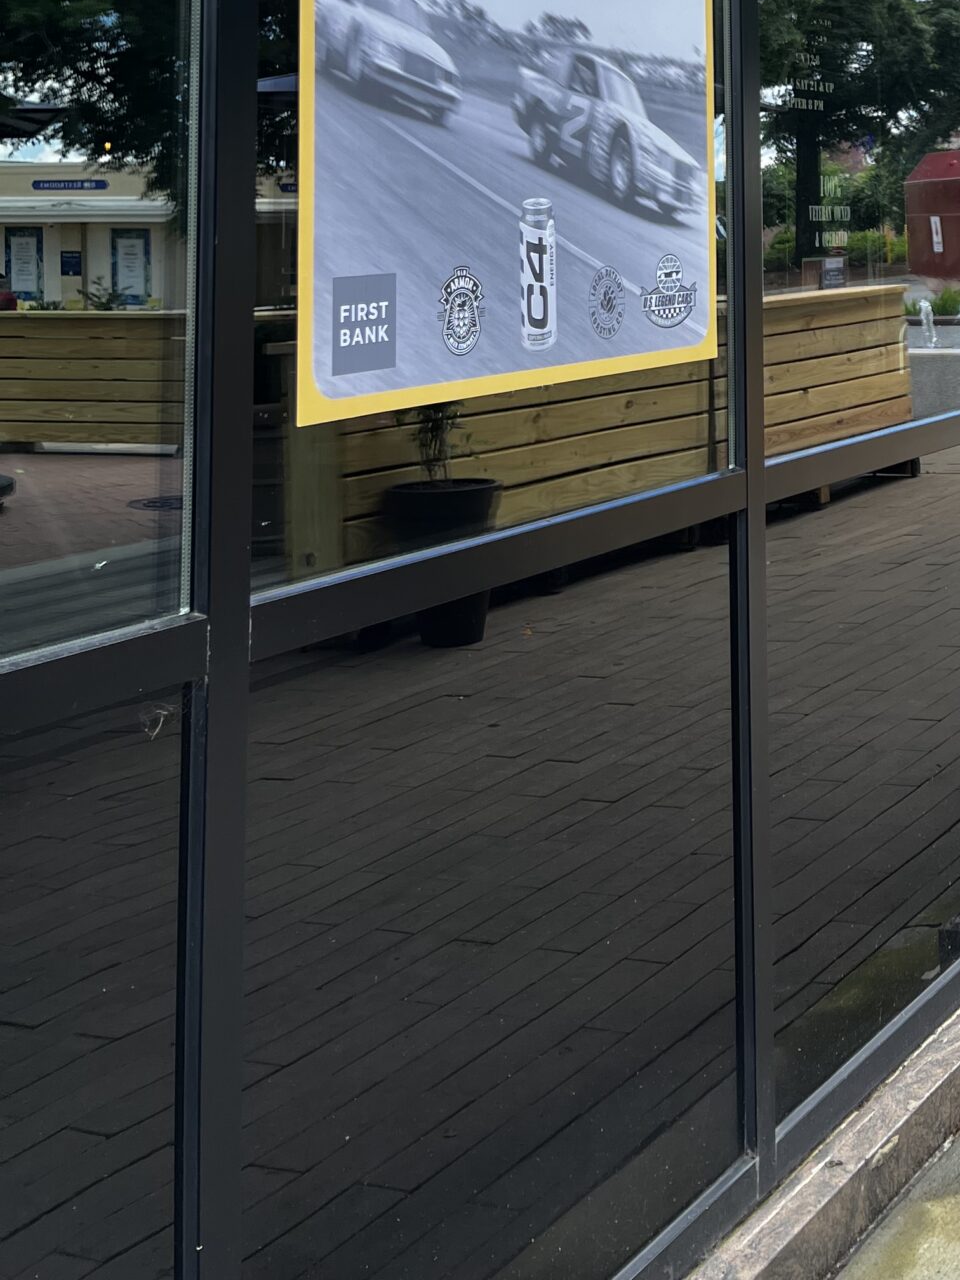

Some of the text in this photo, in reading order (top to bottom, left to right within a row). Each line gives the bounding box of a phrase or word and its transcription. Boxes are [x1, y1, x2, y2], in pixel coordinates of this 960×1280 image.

[825, 82, 835, 94] UP
[808, 99, 813, 110] 8
[814, 99, 824, 111] PM
[820, 175, 842, 197] 100%
[450, 276, 475, 292] ARMOR
[525, 236, 549, 330] C4
[654, 294, 677, 308] LEGEND
[676, 292, 693, 306] CARS
[340, 301, 389, 323] FIRST
[339, 324, 390, 348] BANK
